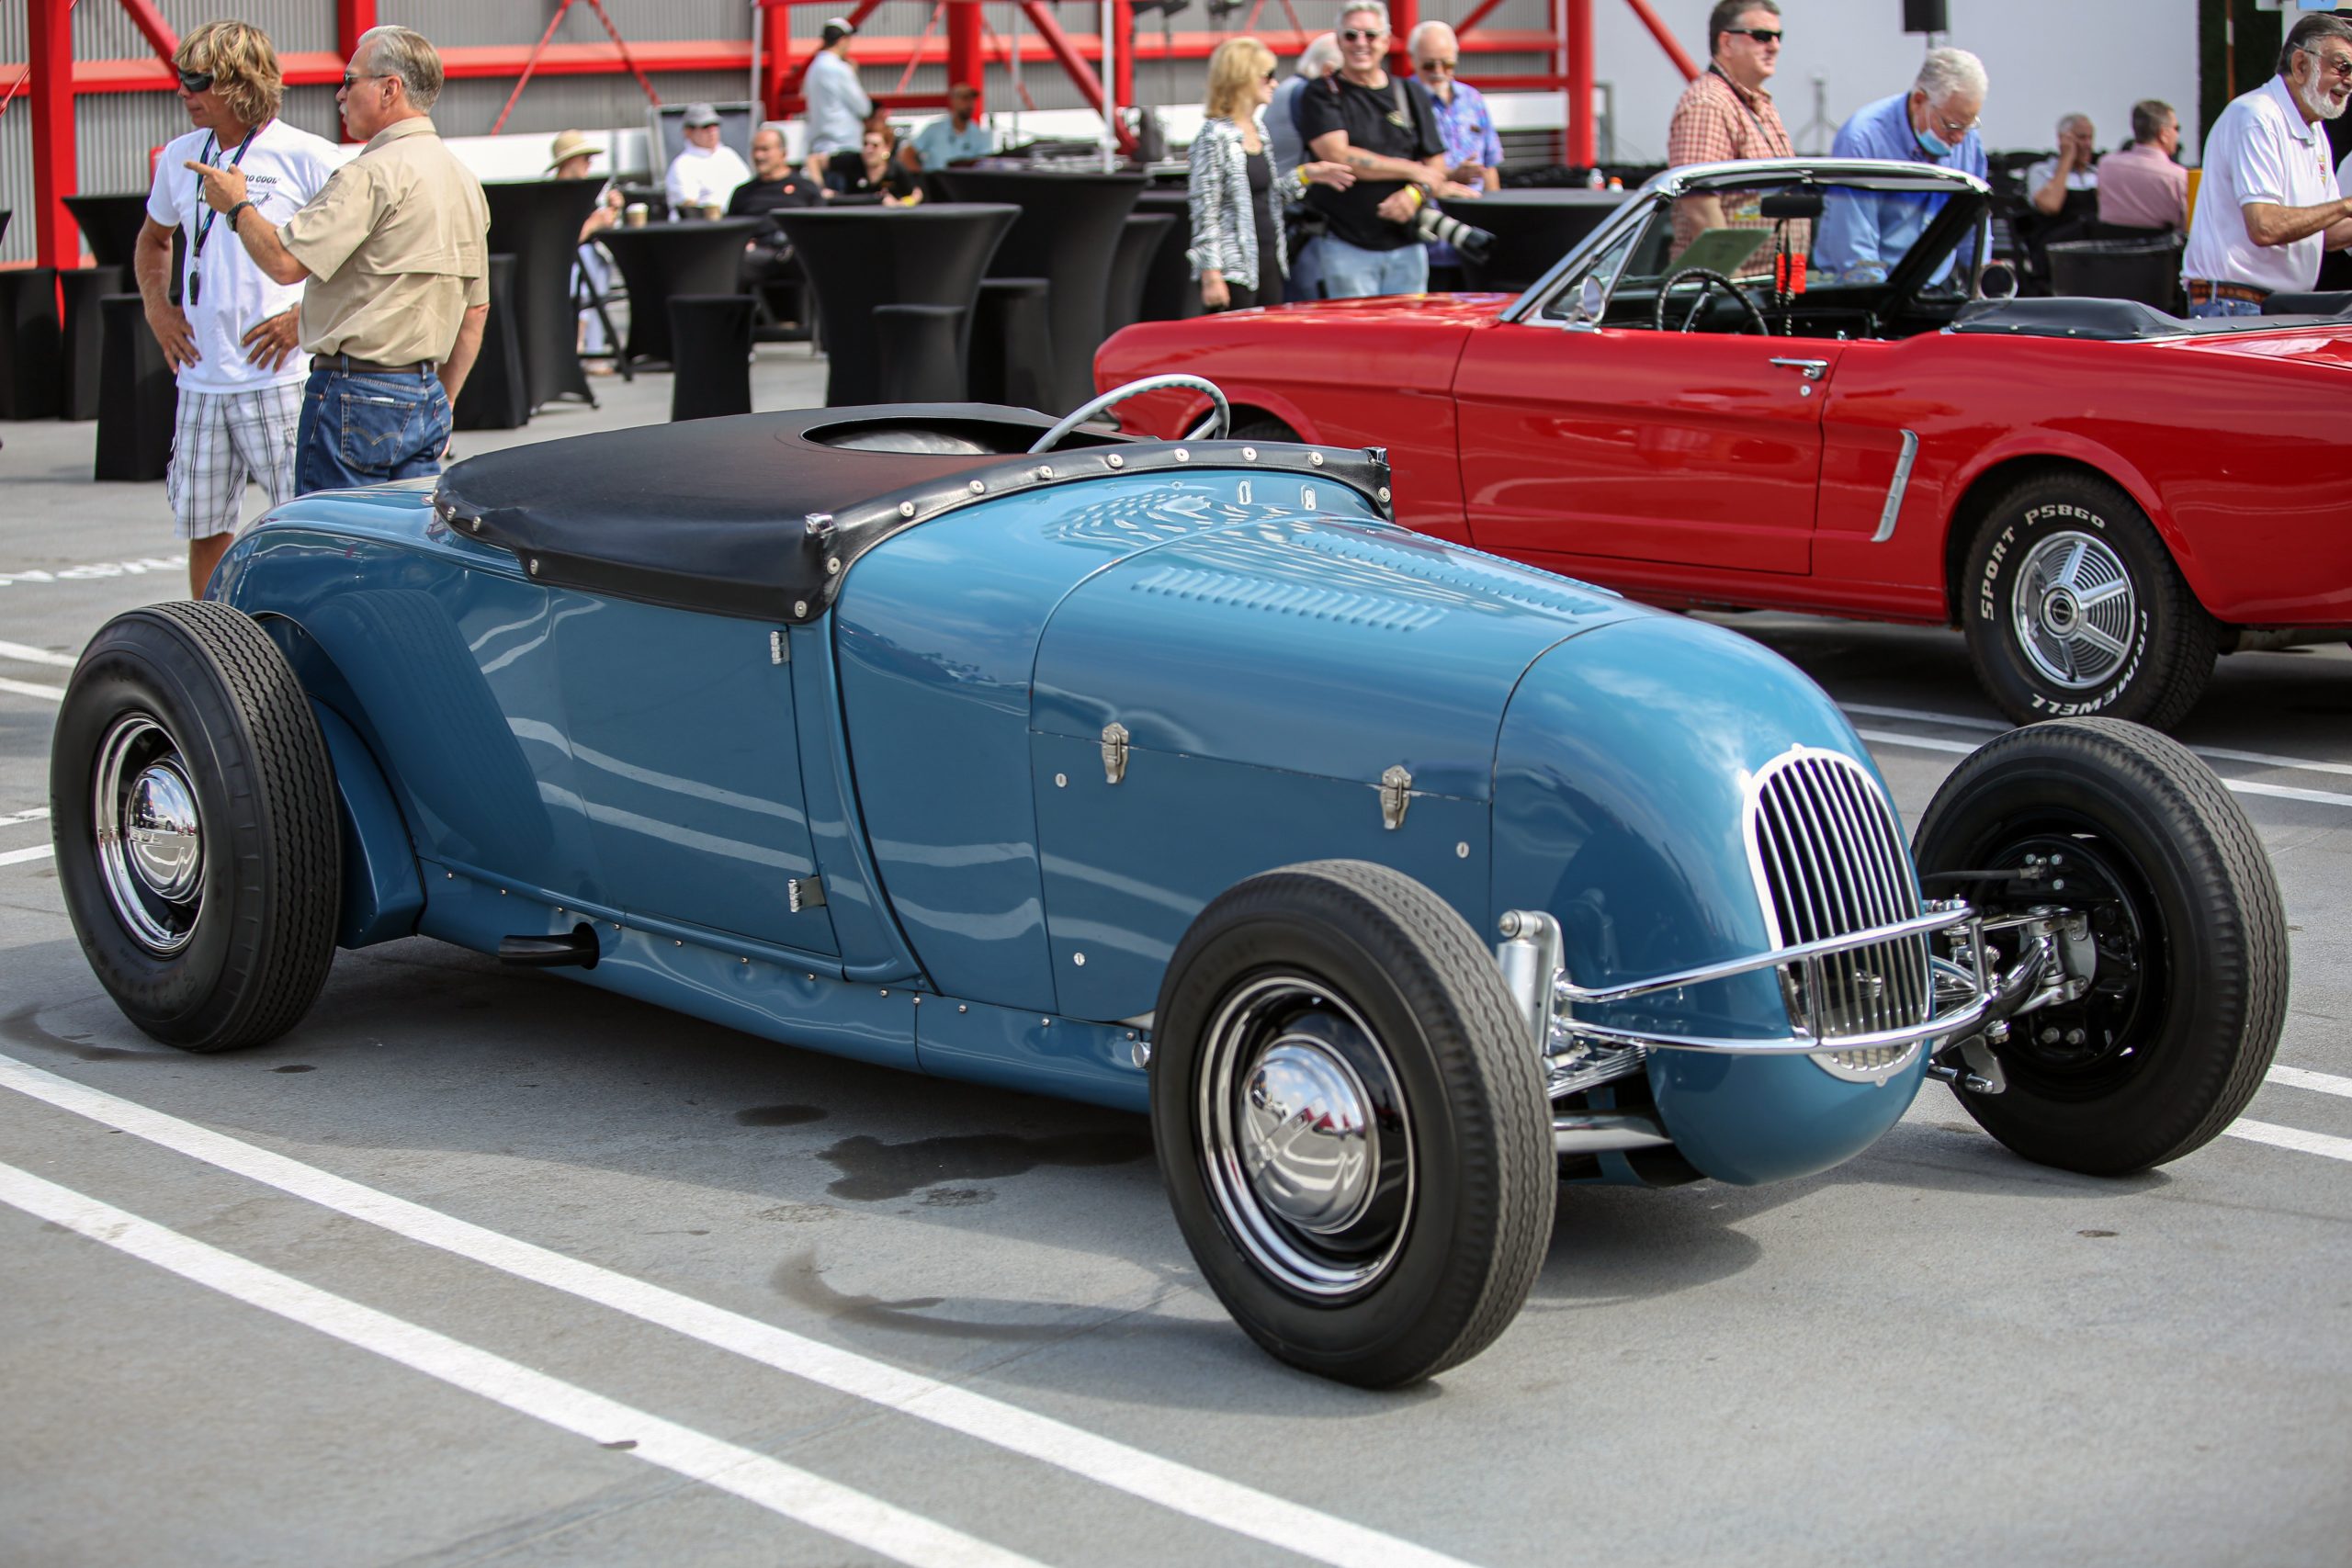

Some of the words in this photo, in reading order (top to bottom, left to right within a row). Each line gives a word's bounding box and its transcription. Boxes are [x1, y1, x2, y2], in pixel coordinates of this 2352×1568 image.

[255, 175, 277, 184] COOL
[1981, 525, 2015, 621] SPORT
[2024, 504, 2106, 528] PS860
[2031, 609, 2148, 716] PRIMEWELL
